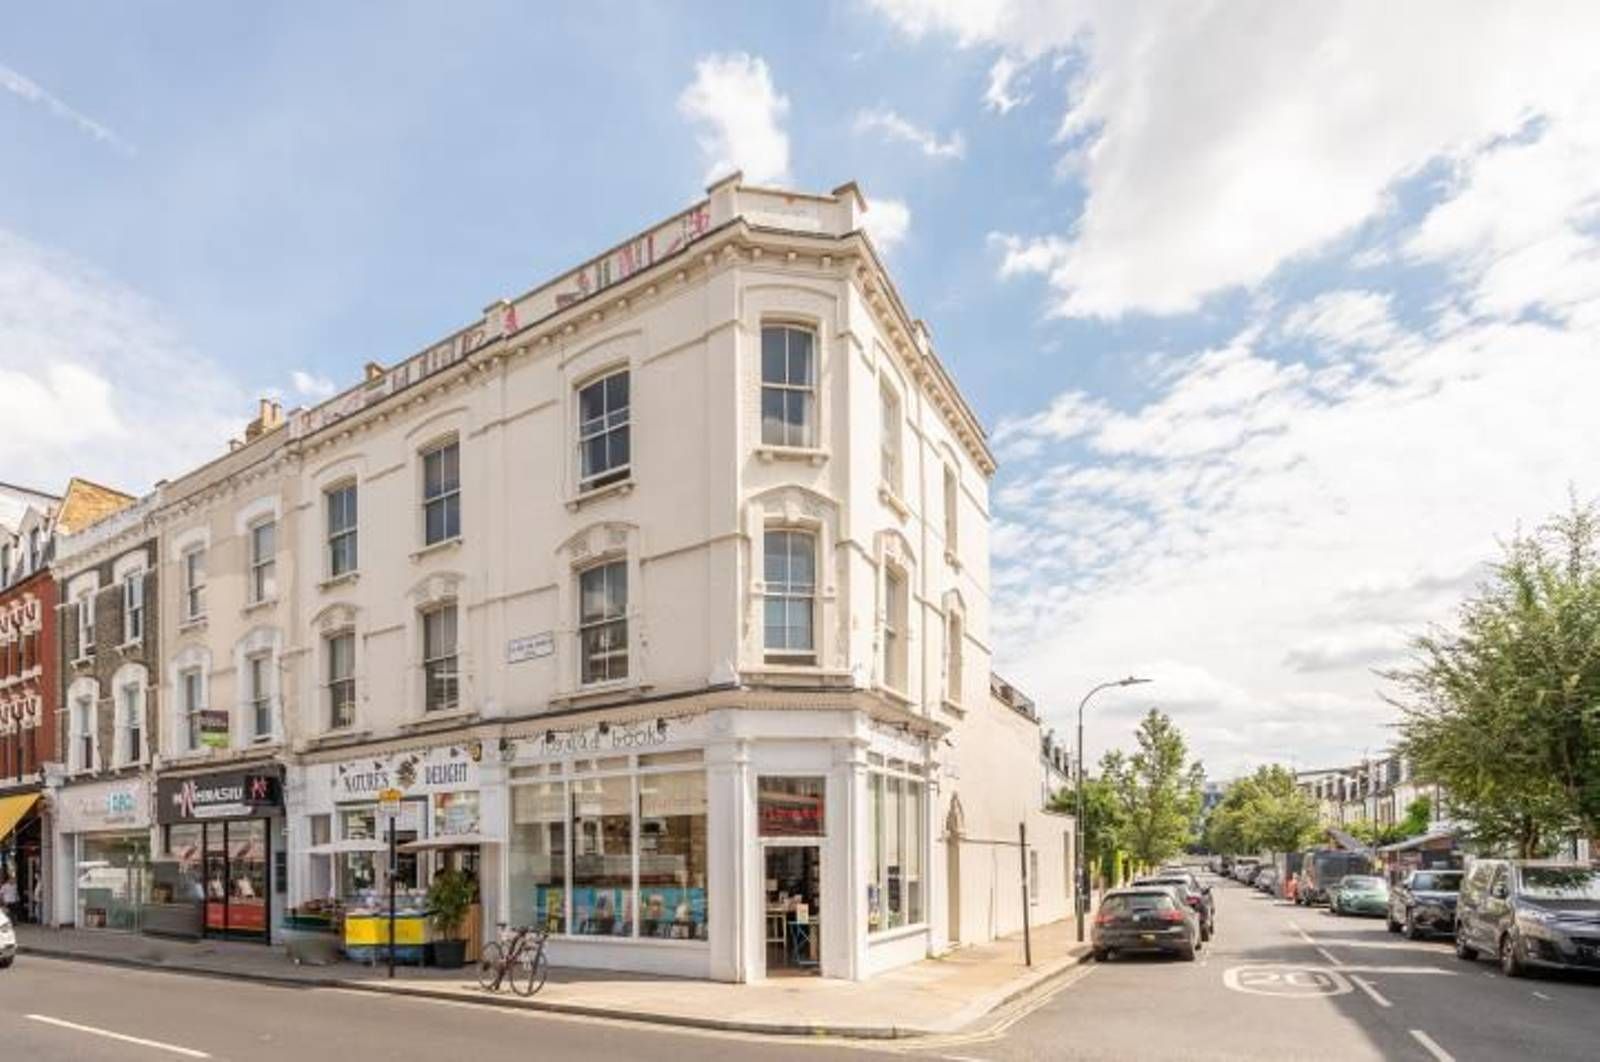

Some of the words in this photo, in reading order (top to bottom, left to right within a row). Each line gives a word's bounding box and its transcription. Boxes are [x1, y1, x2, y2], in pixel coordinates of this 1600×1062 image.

[612, 725, 667, 748] books
[425, 762, 468, 785] DELIGHT
[1239, 971, 1332, 988] 20
